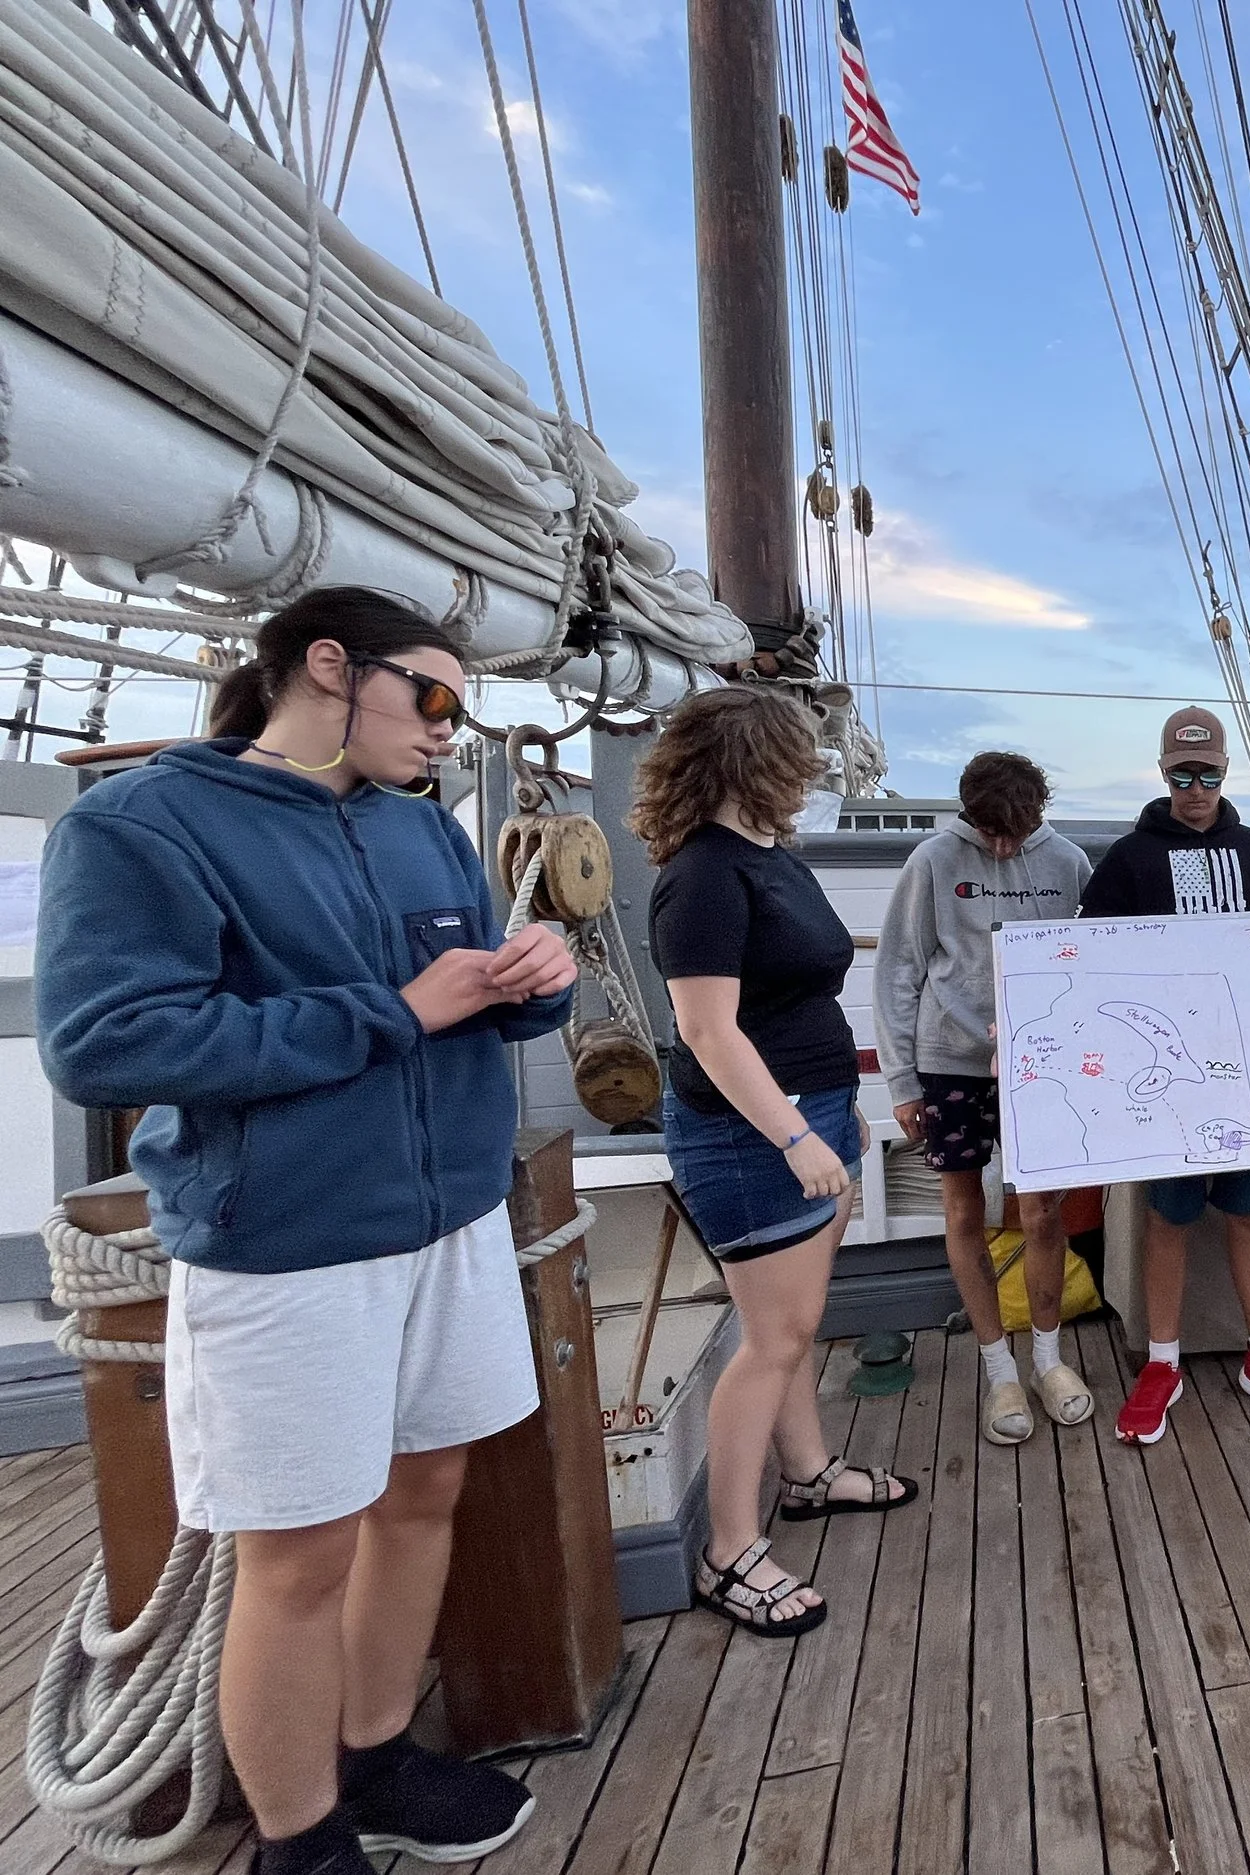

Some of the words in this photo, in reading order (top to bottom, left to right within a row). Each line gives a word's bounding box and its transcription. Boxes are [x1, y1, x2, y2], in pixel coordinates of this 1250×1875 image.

[955, 881, 1062, 905] Champion
[1005, 927, 1071, 946] Navigation
[1027, 1035, 1055, 1045] Boston
[1036, 1045, 1064, 1053] Harbor
